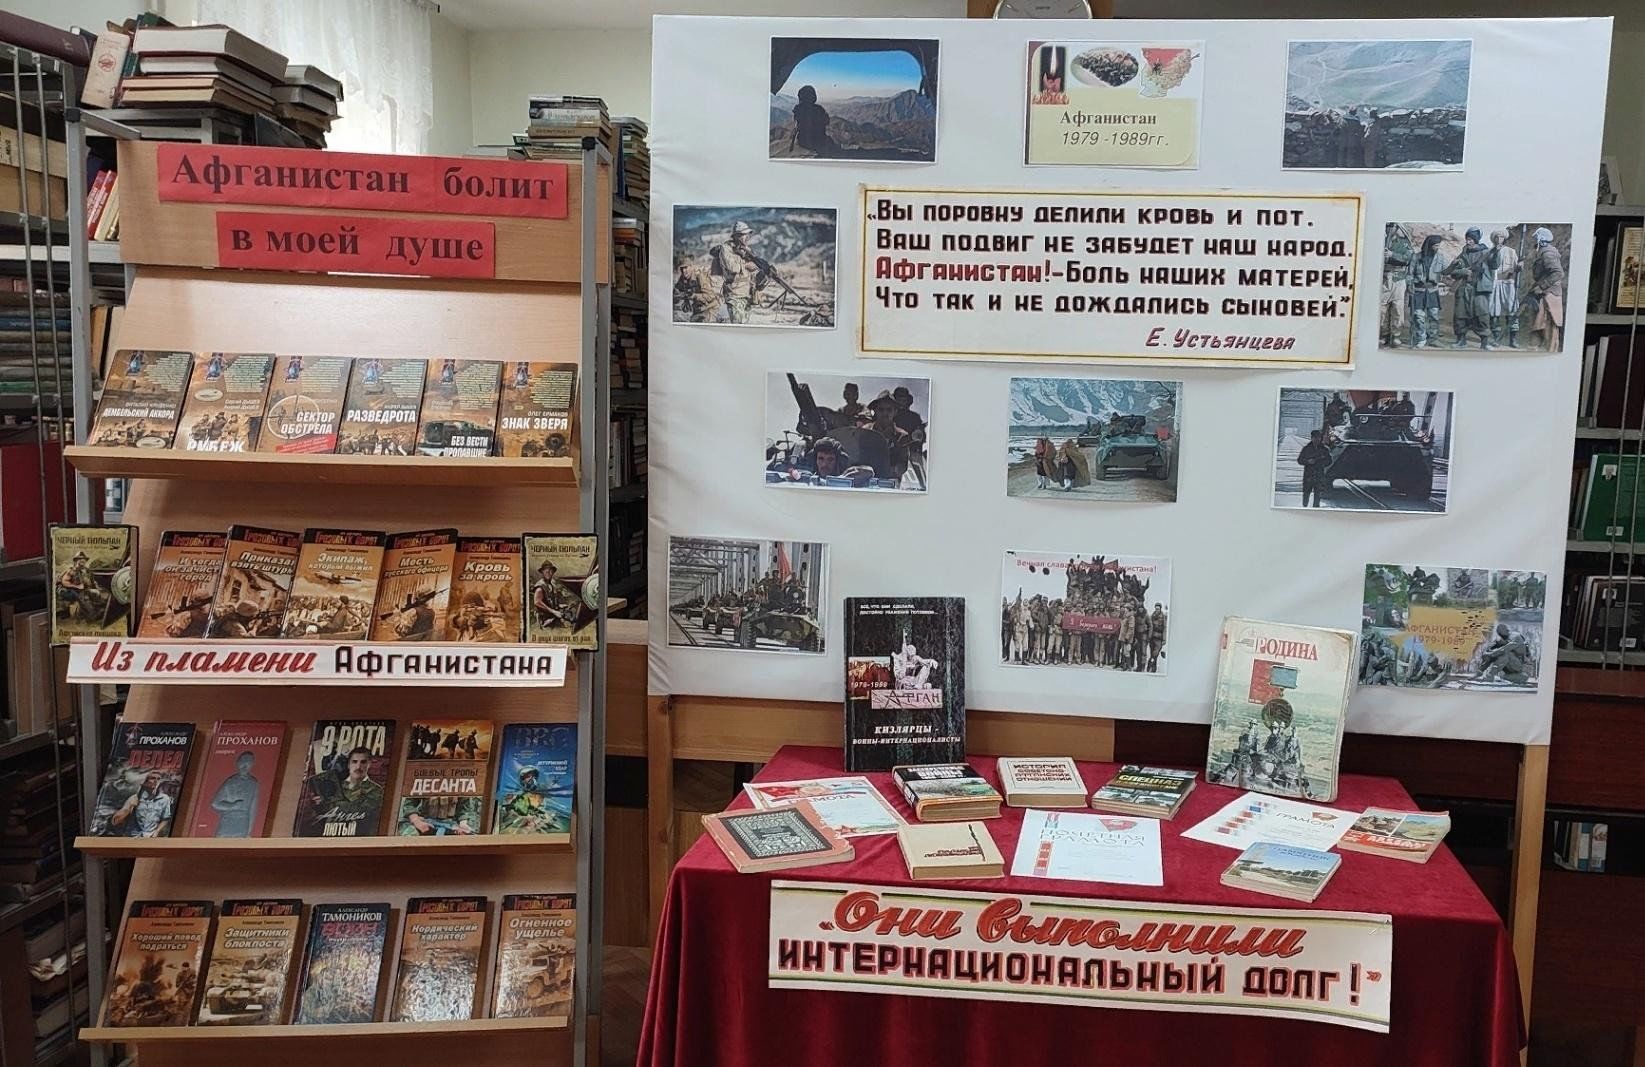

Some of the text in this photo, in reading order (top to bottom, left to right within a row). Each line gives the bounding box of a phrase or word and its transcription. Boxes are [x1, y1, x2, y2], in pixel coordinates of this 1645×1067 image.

[1059, 110, 1157, 127] Афганистан
[1062, 131, 1100, 146] 1979
[171, 153, 554, 200] Афганистан болит
[232, 224, 485, 262] в моей душе
[1145, 327, 1168, 348] Е.
[102, 406, 175, 420] ДЕМБЕЛЬСКИЙ АККОРД
[296, 411, 336, 423] СЕКТОР
[346, 409, 416, 424] РАЗВЕДРОТА
[280, 423, 333, 435] ОБСТРЕЛА
[502, 417, 568, 431] ЗНАК ЗВЕРЯ
[450, 435, 489, 448] БЕЗ ВЕСТИ
[400, 556, 434, 567] Месть
[464, 561, 511, 573] Кровь
[476, 574, 513, 582] кровь
[91, 641, 552, 677] Из пламени Афганистана
[874, 726, 932, 734] КИЗЛЯРЦЫ
[138, 736, 188, 746] ПРОХАНОВ
[216, 736, 278, 746] ПРОХАНОВ
[320, 725, 387, 757] 9 РОТА
[410, 778, 477, 796] ДЕСАНТА
[1276, 812, 1335, 829] ГРАМОТА
[323, 820, 357, 837] ЛЮТЫЙ
[321, 912, 383, 922] ТАМОНИКОВ
[509, 917, 573, 929] Огненное
[225, 928, 290, 940] Защитники
[411, 923, 479, 935] Нордический
[515, 927, 566, 940] ущелье
[976, 897, 1307, 959] выполнили
[420, 932, 467, 941] характер
[224, 938, 287, 949] блокпоста
[778, 937, 1226, 994] ИНТЕРНАЦИОНАЛЬНЫЙ
